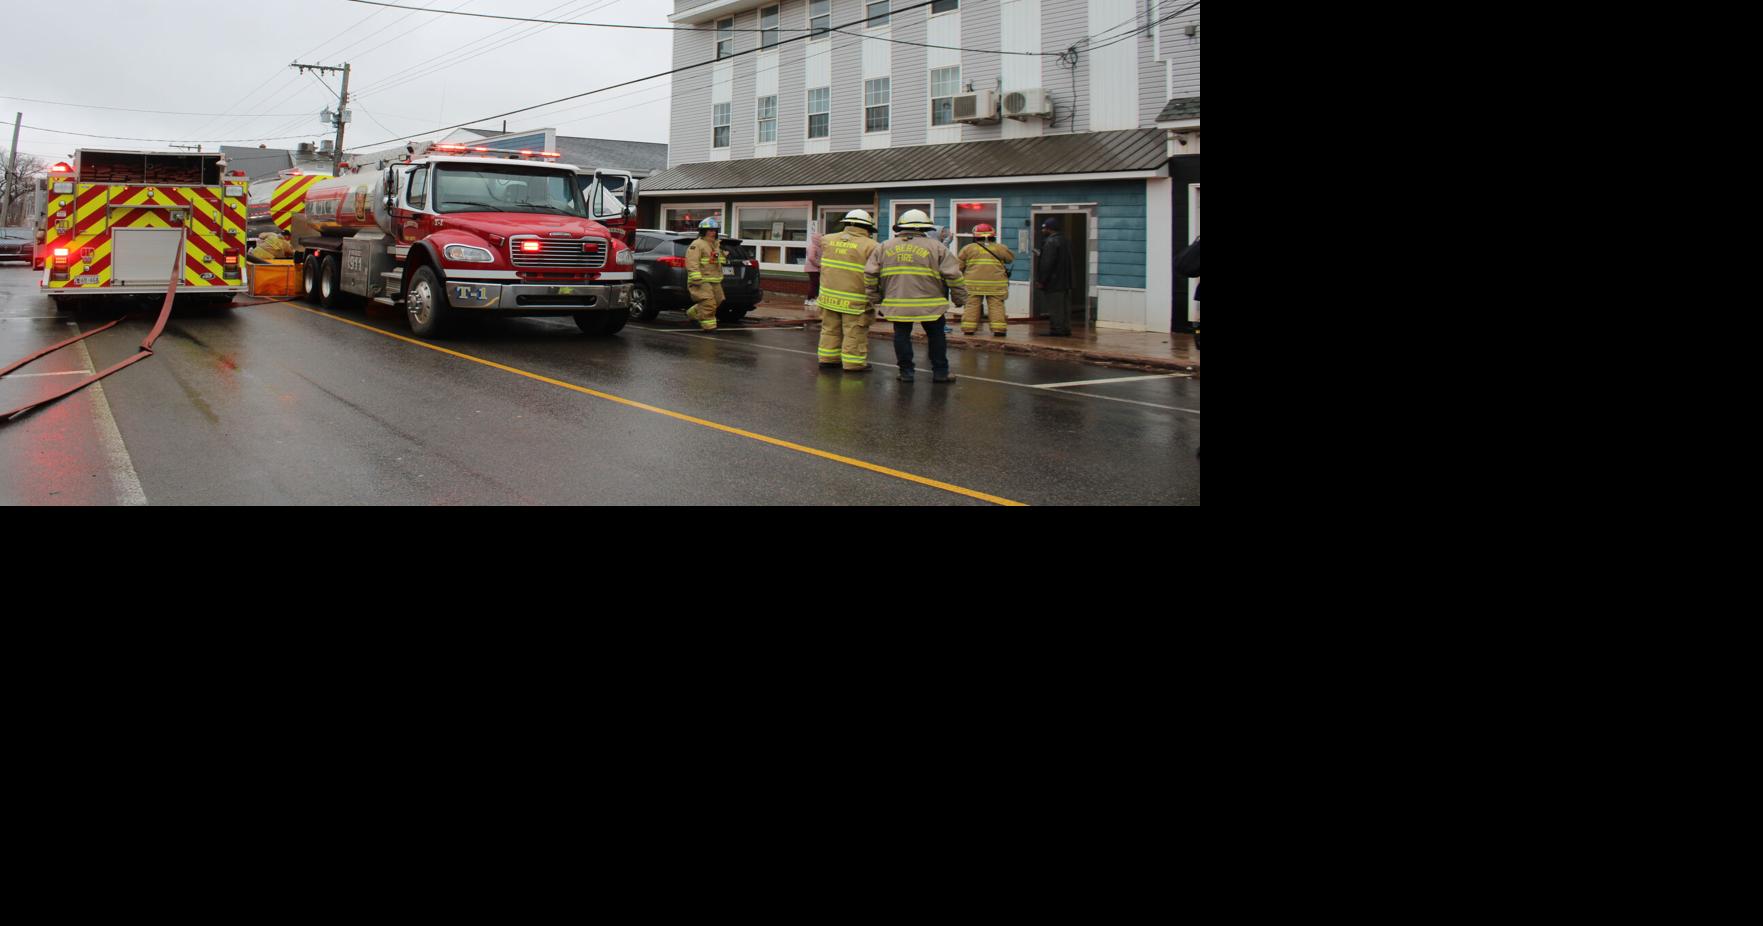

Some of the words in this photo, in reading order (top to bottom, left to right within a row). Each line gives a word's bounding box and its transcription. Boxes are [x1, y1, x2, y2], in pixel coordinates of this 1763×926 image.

[885, 243, 931, 258] ALBERTON
[897, 253, 914, 263] FIRE
[456, 286, 488, 300] T-1
